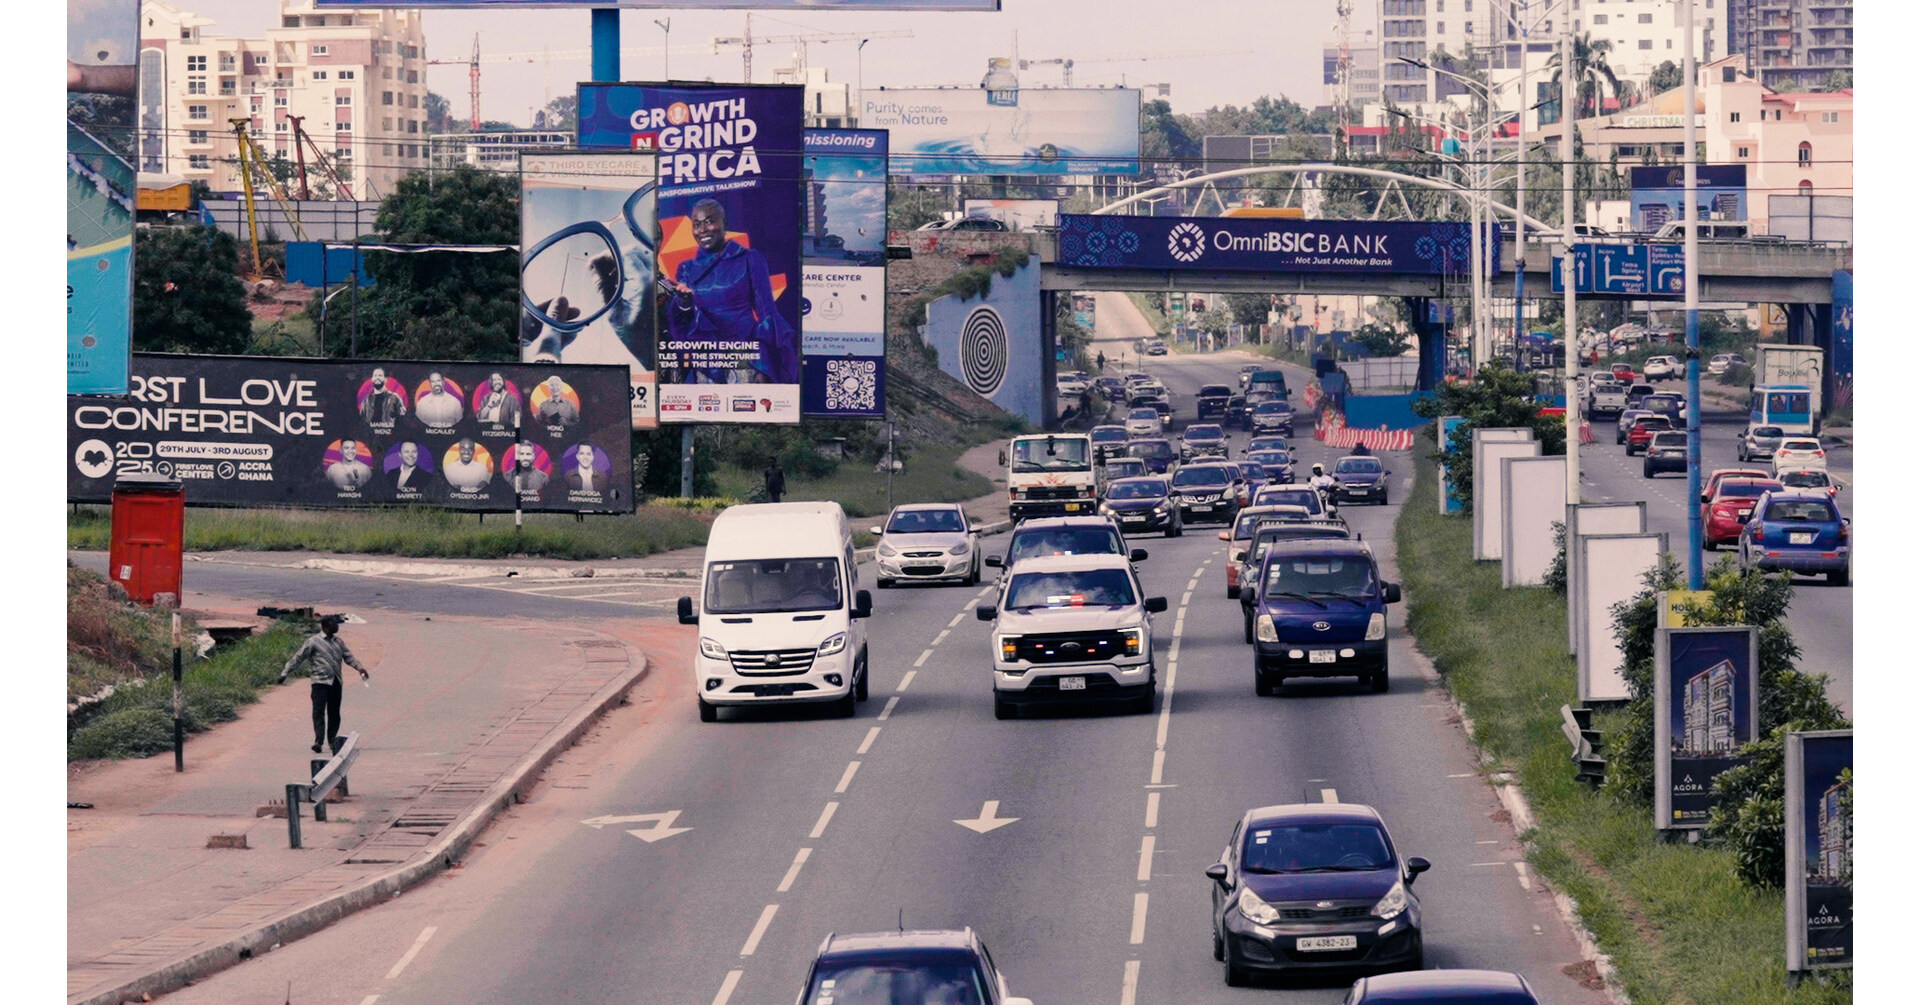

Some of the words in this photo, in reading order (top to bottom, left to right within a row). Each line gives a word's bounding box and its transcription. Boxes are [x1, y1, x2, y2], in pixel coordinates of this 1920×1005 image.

[866, 101, 904, 116] Purity
[909, 105, 943, 114] comes
[875, 115, 899, 125] from
[901, 114, 948, 125] Nature
[1627, 117, 1685, 127] CHRISTMA
[658, 118, 757, 152] GRIND
[804, 134, 876, 148] missioning
[550, 161, 584, 169] THIRD
[587, 161, 640, 169] EYECARE
[658, 146, 762, 186] FRICA
[658, 184, 714, 197] ANSFORMATIVE
[716, 180, 756, 190] TALKSHOW
[1214, 230, 1315, 252] OmniBSIC
[1319, 234, 1389, 254] BANK
[1295, 256, 1310, 264] Not
[1312, 257, 1330, 265] Just
[1332, 257, 1367, 266] Another
[1370, 258, 1392, 266] Bank
[826, 274, 862, 282] CENTER
[668, 341, 717, 350] GROWTH
[718, 341, 760, 350] ENGINE
[131, 375, 186, 404] RST
[199, 377, 318, 407] LOVE
[74, 406, 324, 436] CONFERENCE
[116, 442, 153, 458] 20
[160, 445, 184, 453] 29TH
[185, 446, 206, 454] JULY
[213, 446, 230, 454] 3RD
[232, 448, 268, 456] AUGUST
[116, 460, 153, 476] 25
[238, 462, 272, 471] ACCRA
[175, 471, 214, 479] CENTER
[238, 472, 274, 481] GHANA
[1672, 604, 1690, 612] HOL
[1674, 784, 1704, 792] AGORA
[1808, 916, 1840, 925] AGORA
[1302, 940, 1312, 948] GW
